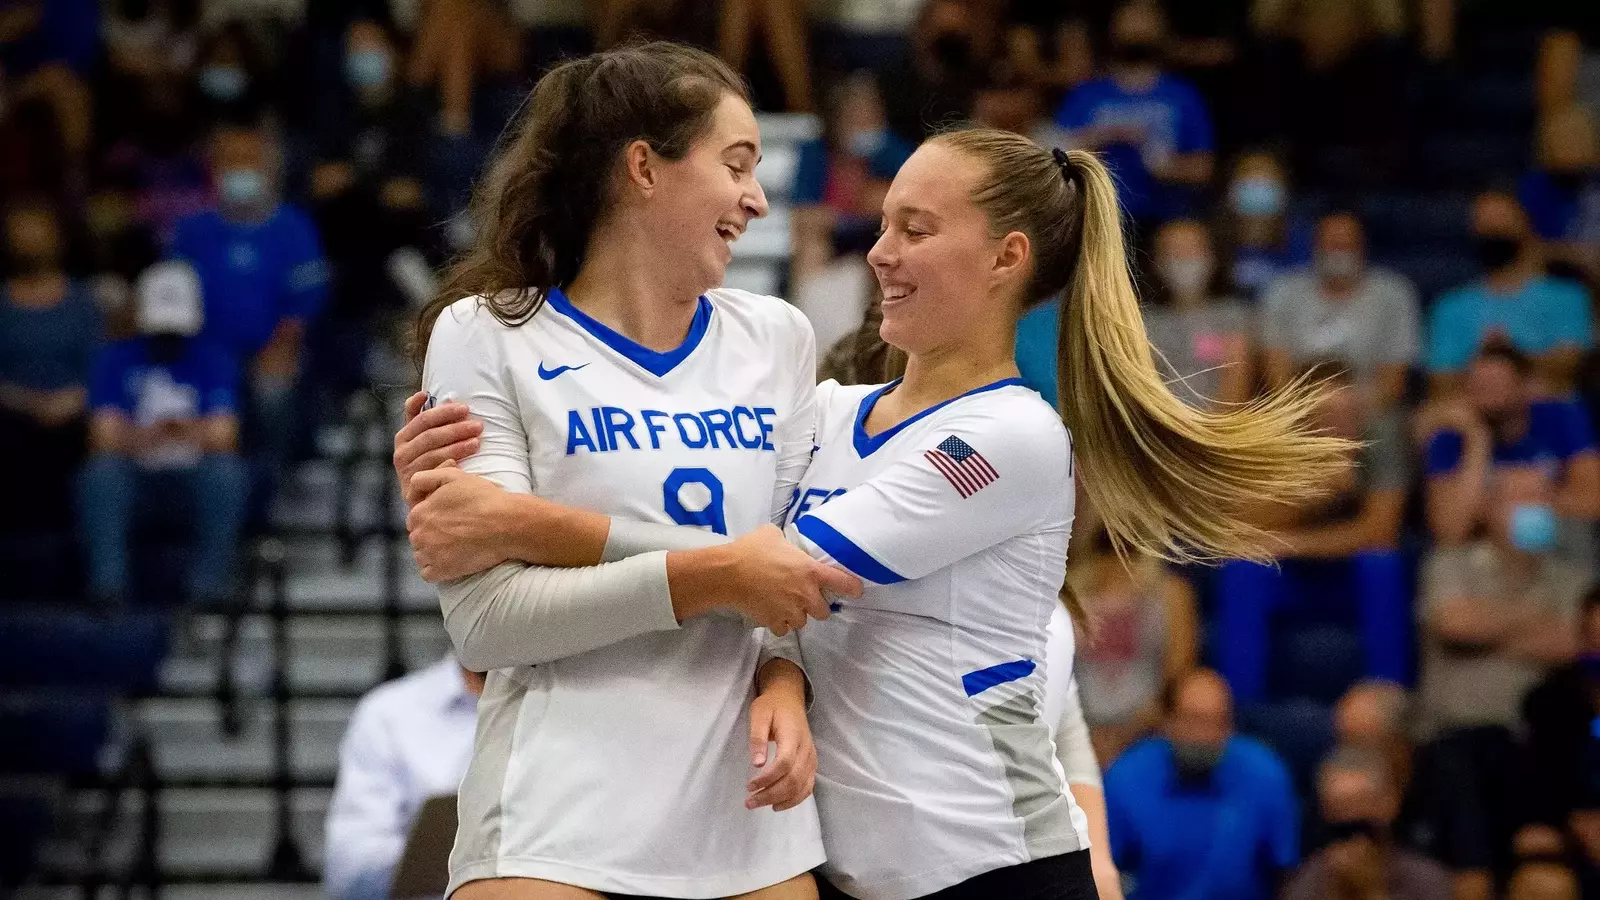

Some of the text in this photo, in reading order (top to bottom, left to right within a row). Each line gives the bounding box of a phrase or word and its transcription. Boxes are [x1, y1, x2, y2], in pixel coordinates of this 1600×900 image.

[566, 405, 776, 455] AIR FORCE
[663, 467, 728, 536] 9
